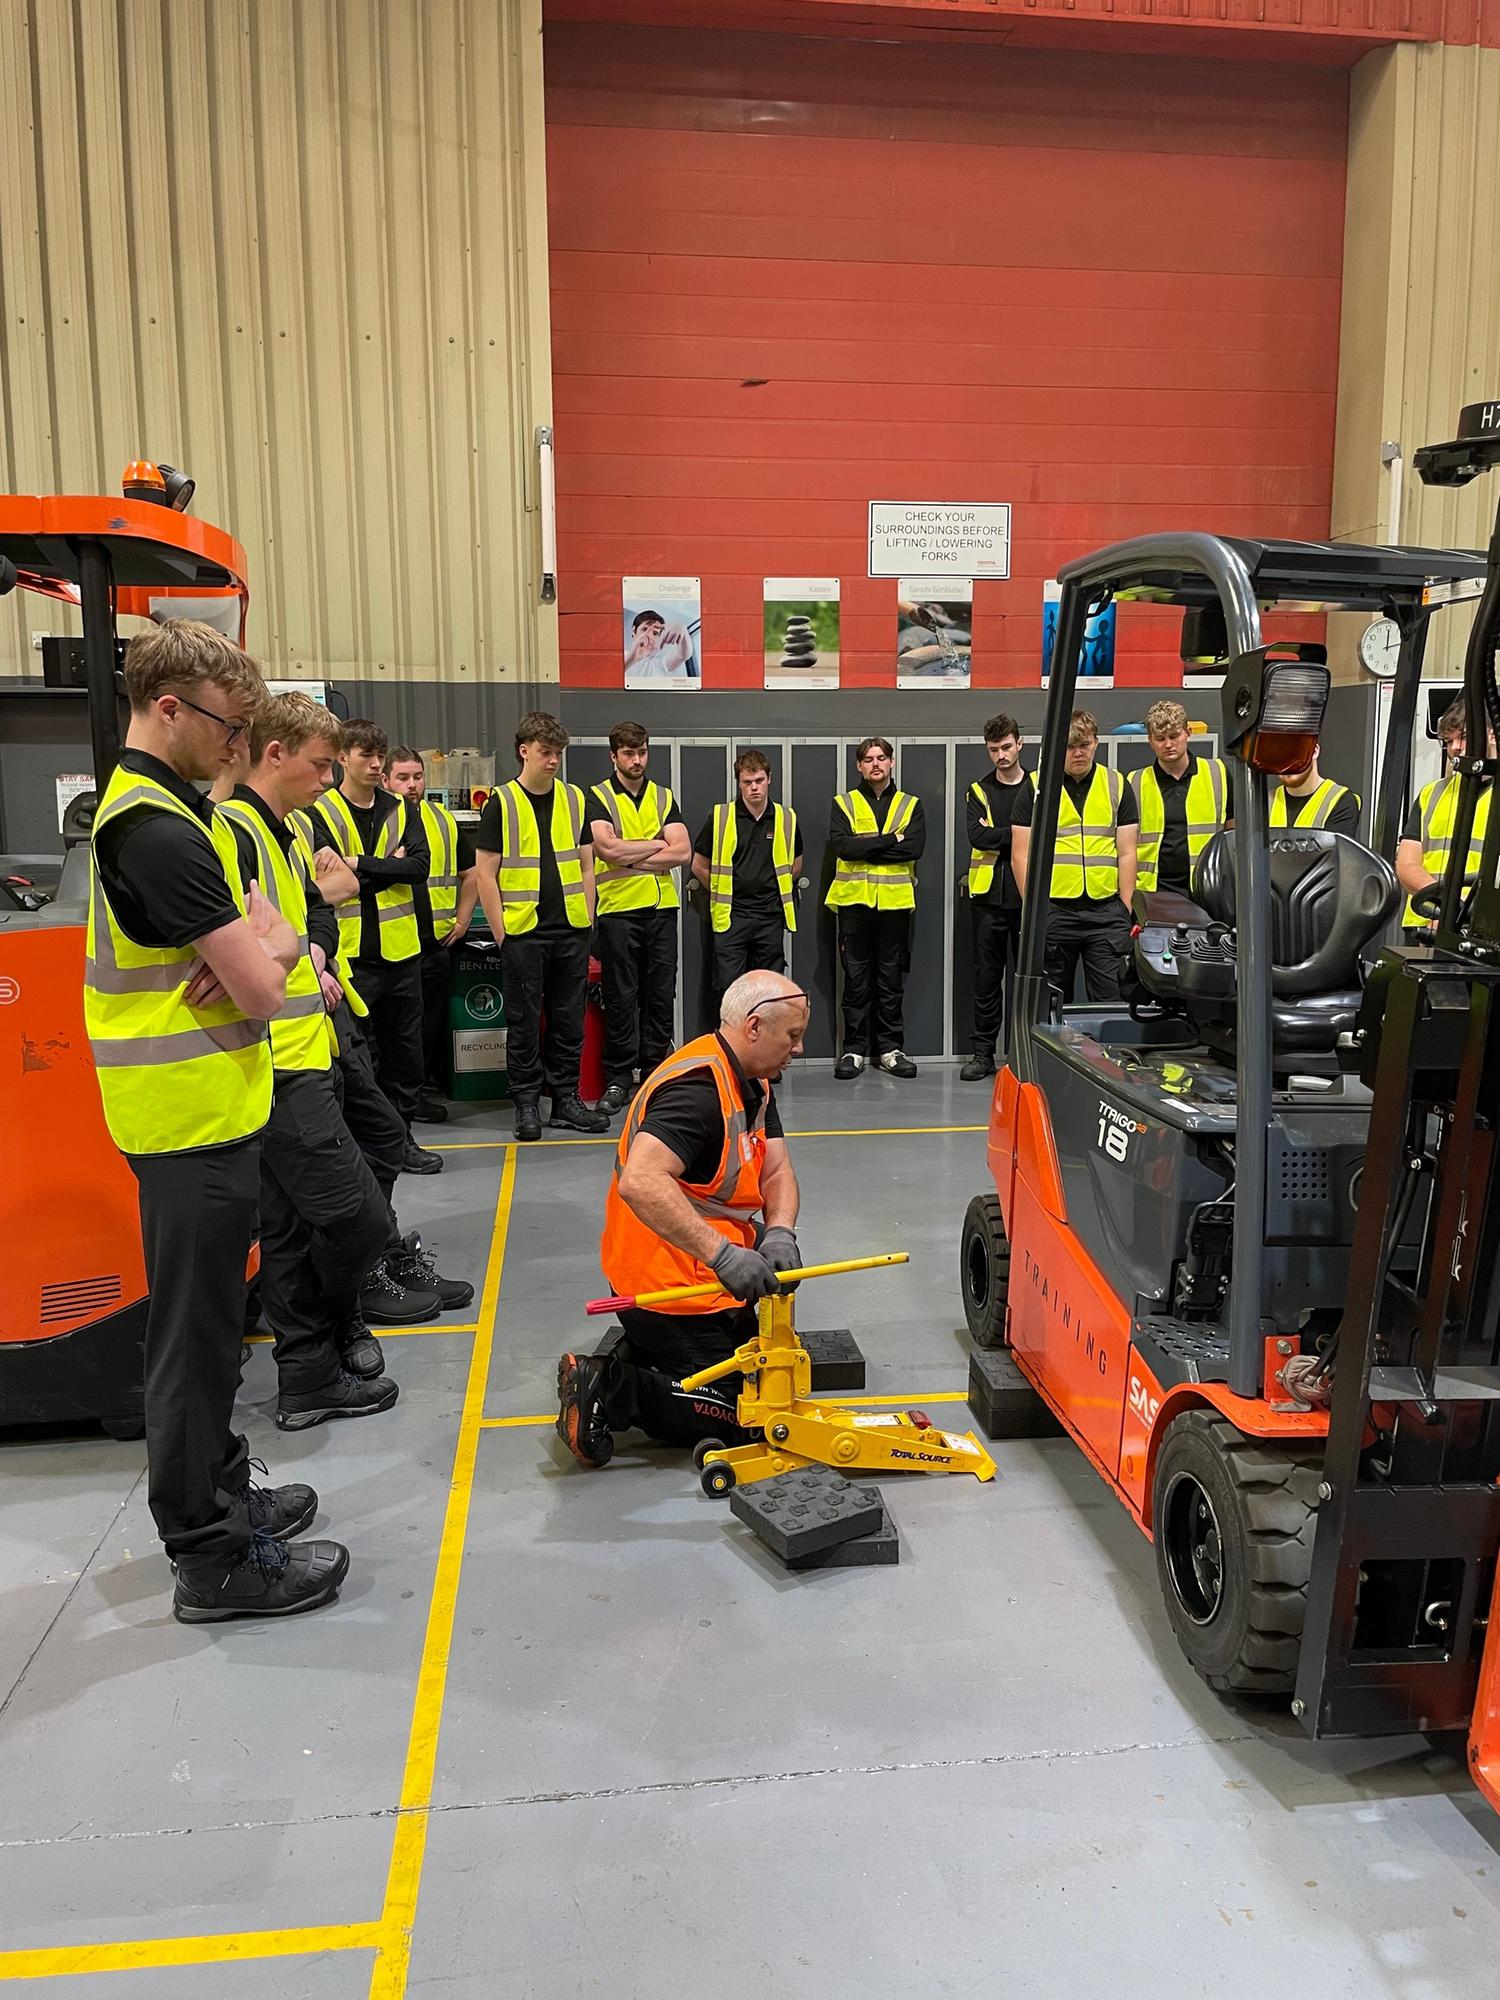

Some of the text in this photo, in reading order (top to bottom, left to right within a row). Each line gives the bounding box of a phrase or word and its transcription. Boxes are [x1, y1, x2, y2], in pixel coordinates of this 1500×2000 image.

[905, 511, 975, 521] CHECK YOUR
[875, 524, 1005, 536] SURROUNDINGS BEFORE
[886, 538, 927, 548] LIFTING
[935, 539, 993, 549] LOWERING
[921, 551, 958, 561] FORKS
[658, 584, 692, 594] Challenge
[1375, 660, 1379, 668] 7
[1269, 839, 1321, 853] YOTA
[460, 961, 501, 971] BENTLE
[1097, 1117, 1129, 1162] 18
[1025, 1250, 1107, 1375] TRAINING
[693, 1401, 740, 1426] OYOTA
[917, 1452, 953, 1464] SOURCE
